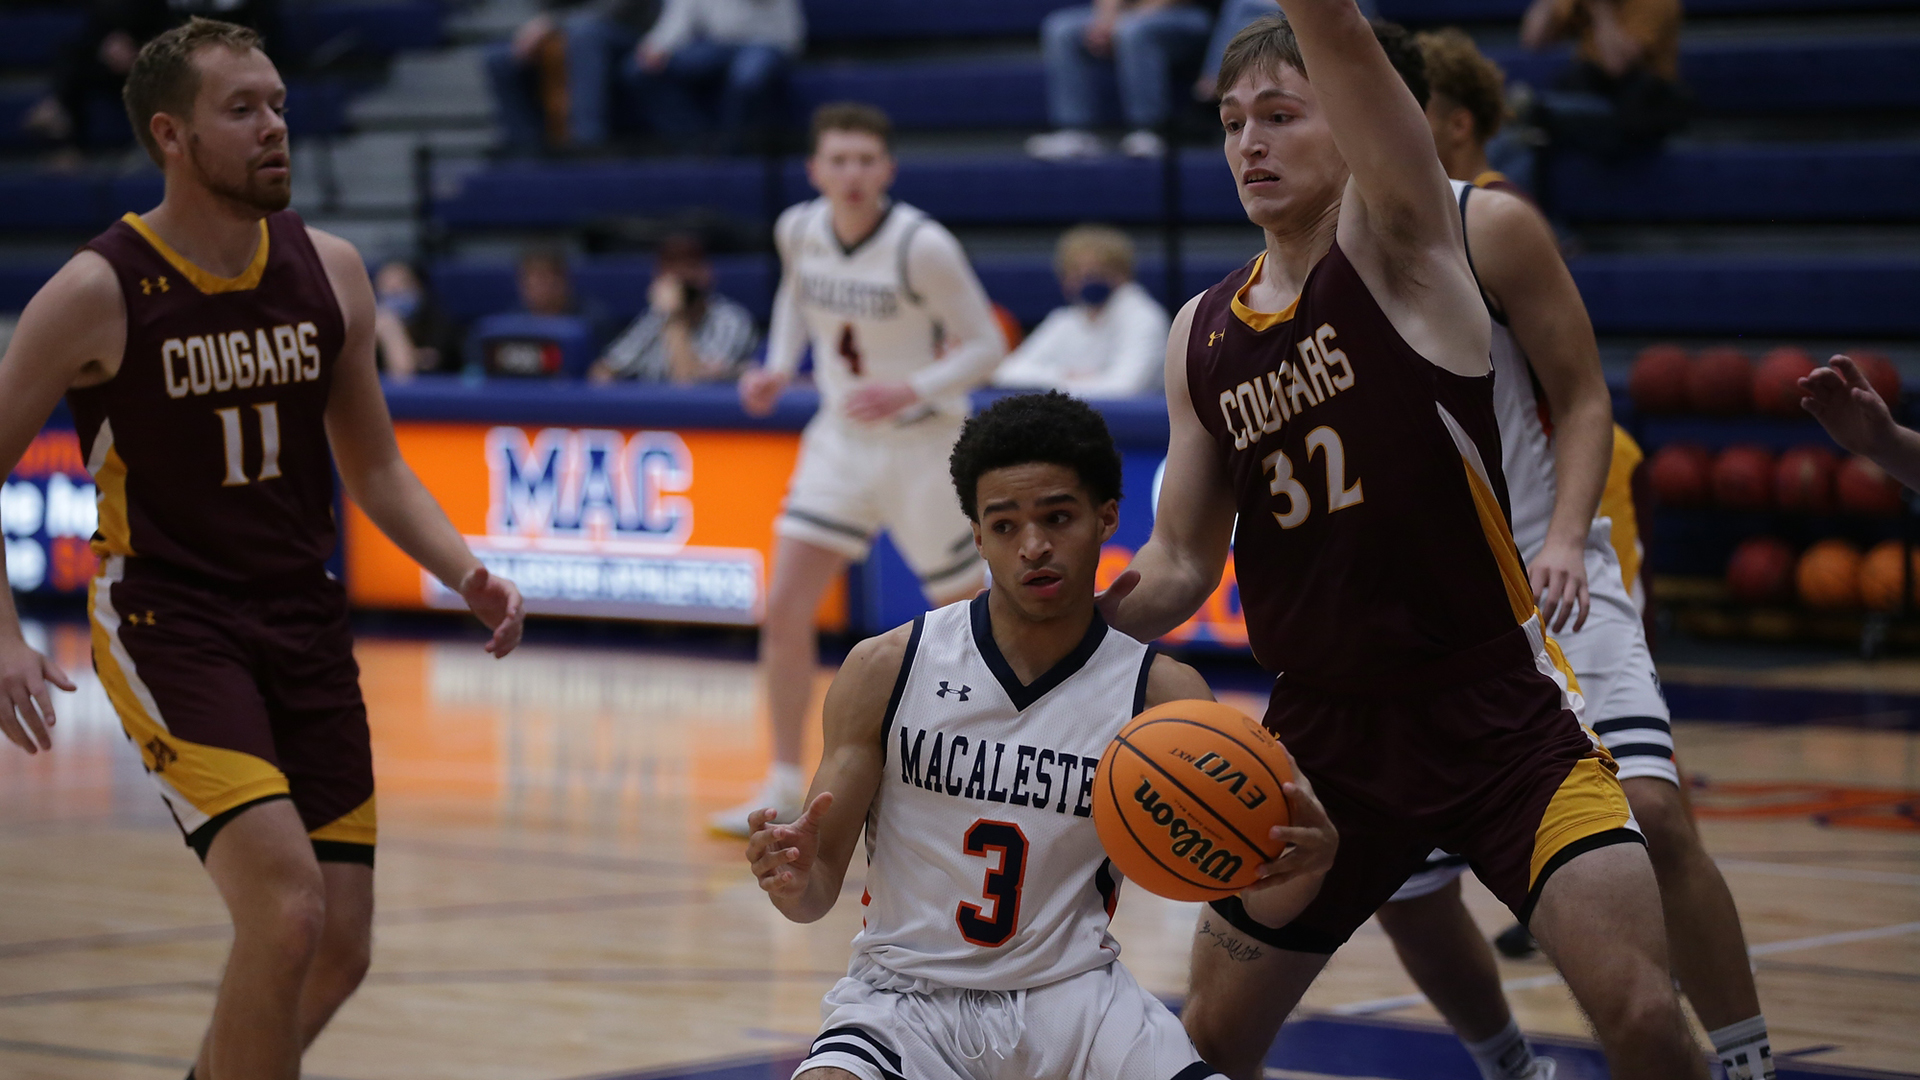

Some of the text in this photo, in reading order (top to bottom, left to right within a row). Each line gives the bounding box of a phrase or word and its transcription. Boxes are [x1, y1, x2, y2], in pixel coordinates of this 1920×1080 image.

[161, 321, 321, 399] COUGARS
[838, 321, 864, 378] 4
[1219, 322, 1355, 451] COUGARS
[213, 401, 282, 487] 11
[488, 428, 692, 546] MAC
[1261, 425, 1365, 530] 32
[900, 726, 1099, 818] MACALESTE
[1170, 747, 1267, 810] EVO NXT
[1134, 777, 1243, 884] Wilson
[955, 817, 1030, 948] 3
